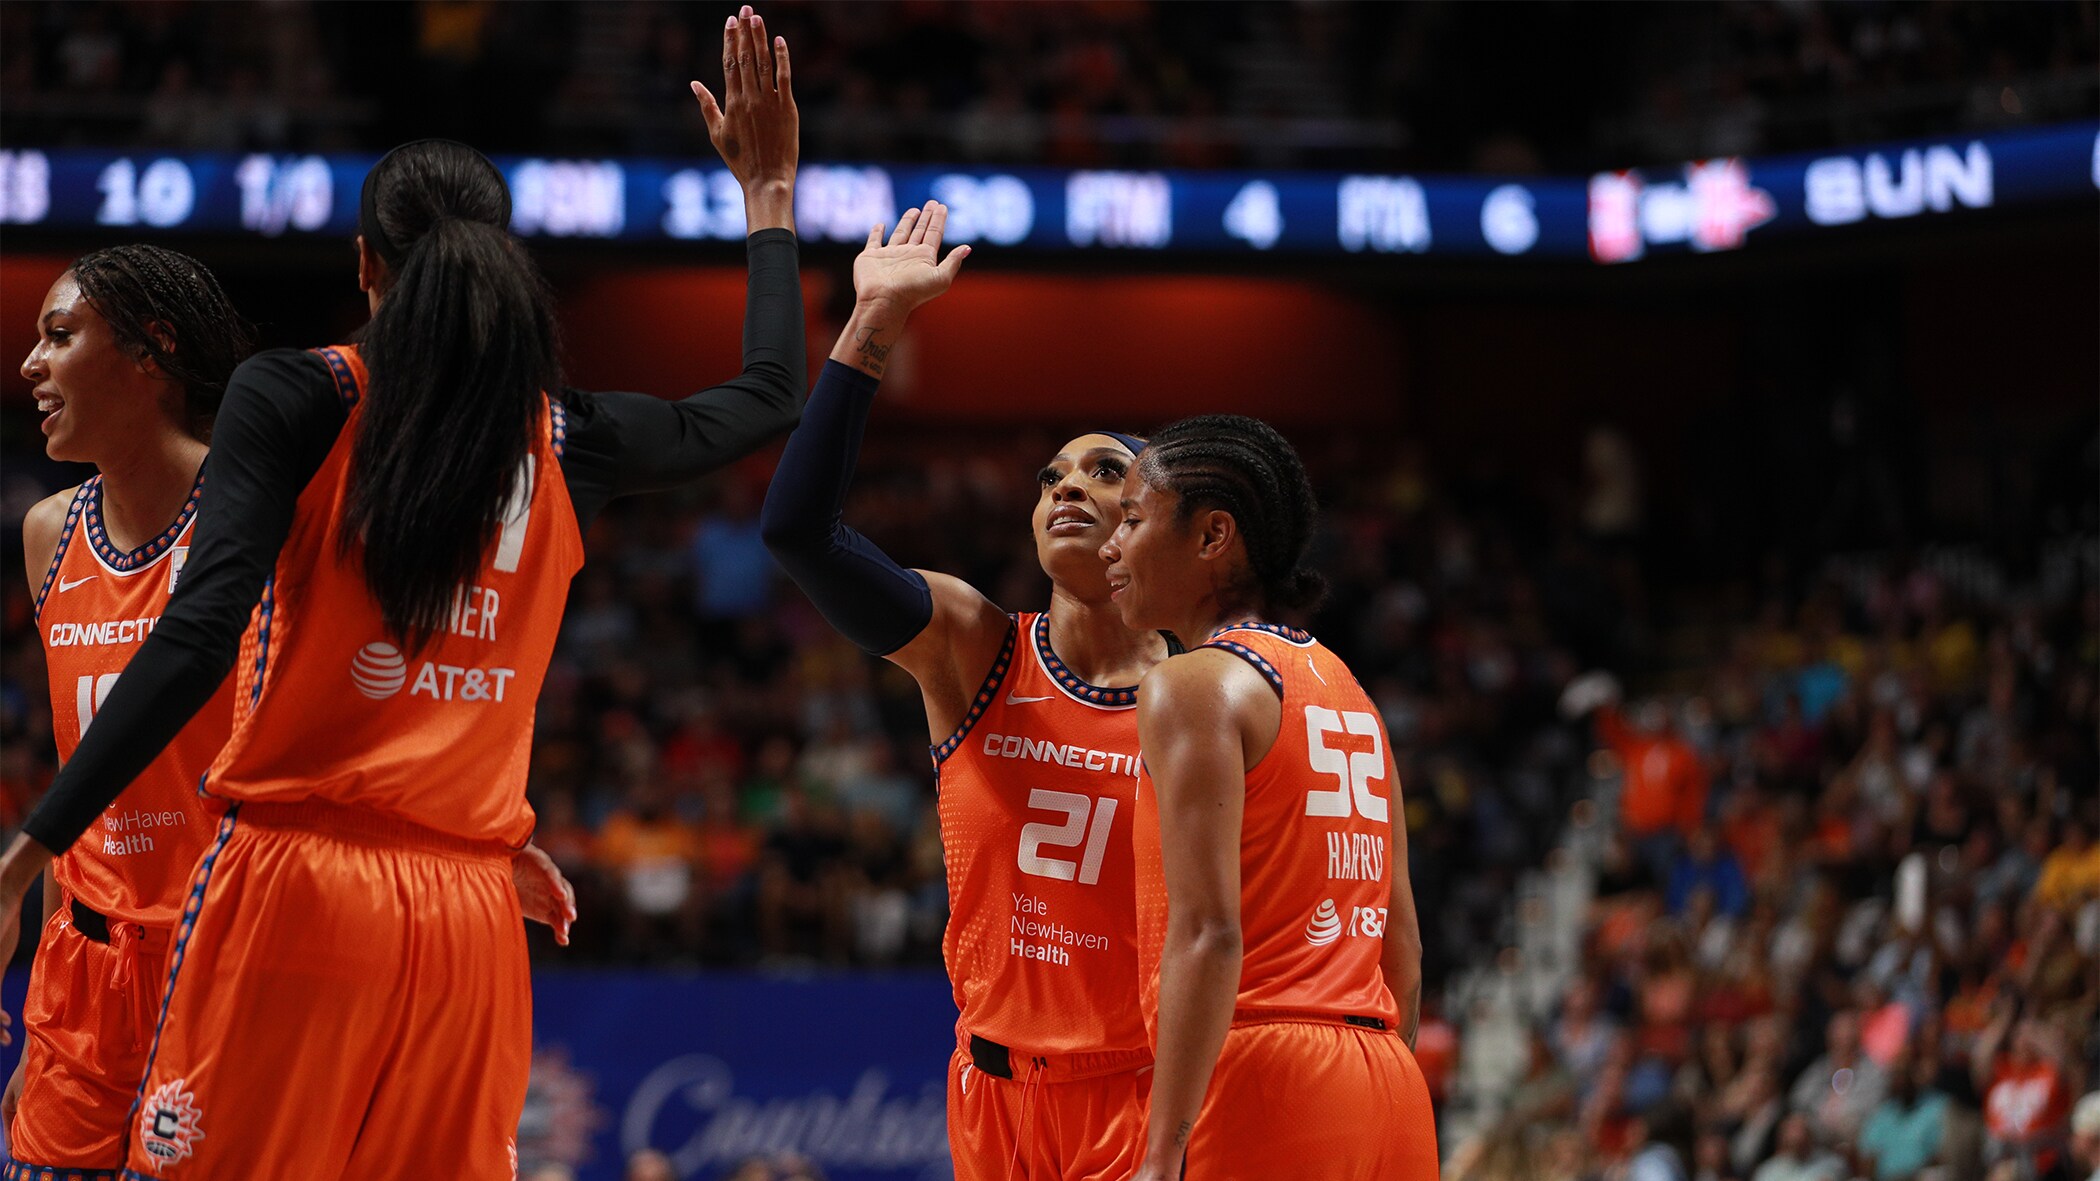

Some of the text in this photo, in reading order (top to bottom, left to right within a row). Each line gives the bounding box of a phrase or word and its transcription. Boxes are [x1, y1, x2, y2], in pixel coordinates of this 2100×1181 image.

[96, 157, 195, 228] 10
[1222, 180, 1283, 250] 4
[1480, 184, 1539, 255] 6
[410, 661, 515, 702] AT&T
[1304, 705, 1388, 823] 52
[103, 833, 154, 856] Health
[1017, 788, 1118, 885] 21
[1327, 831, 1384, 882] HARRIS
[1012, 892, 1047, 916] Yale
[1011, 915, 1109, 951] NewHaven
[1010, 938, 1069, 967] Health
[153, 1109, 178, 1140] C
